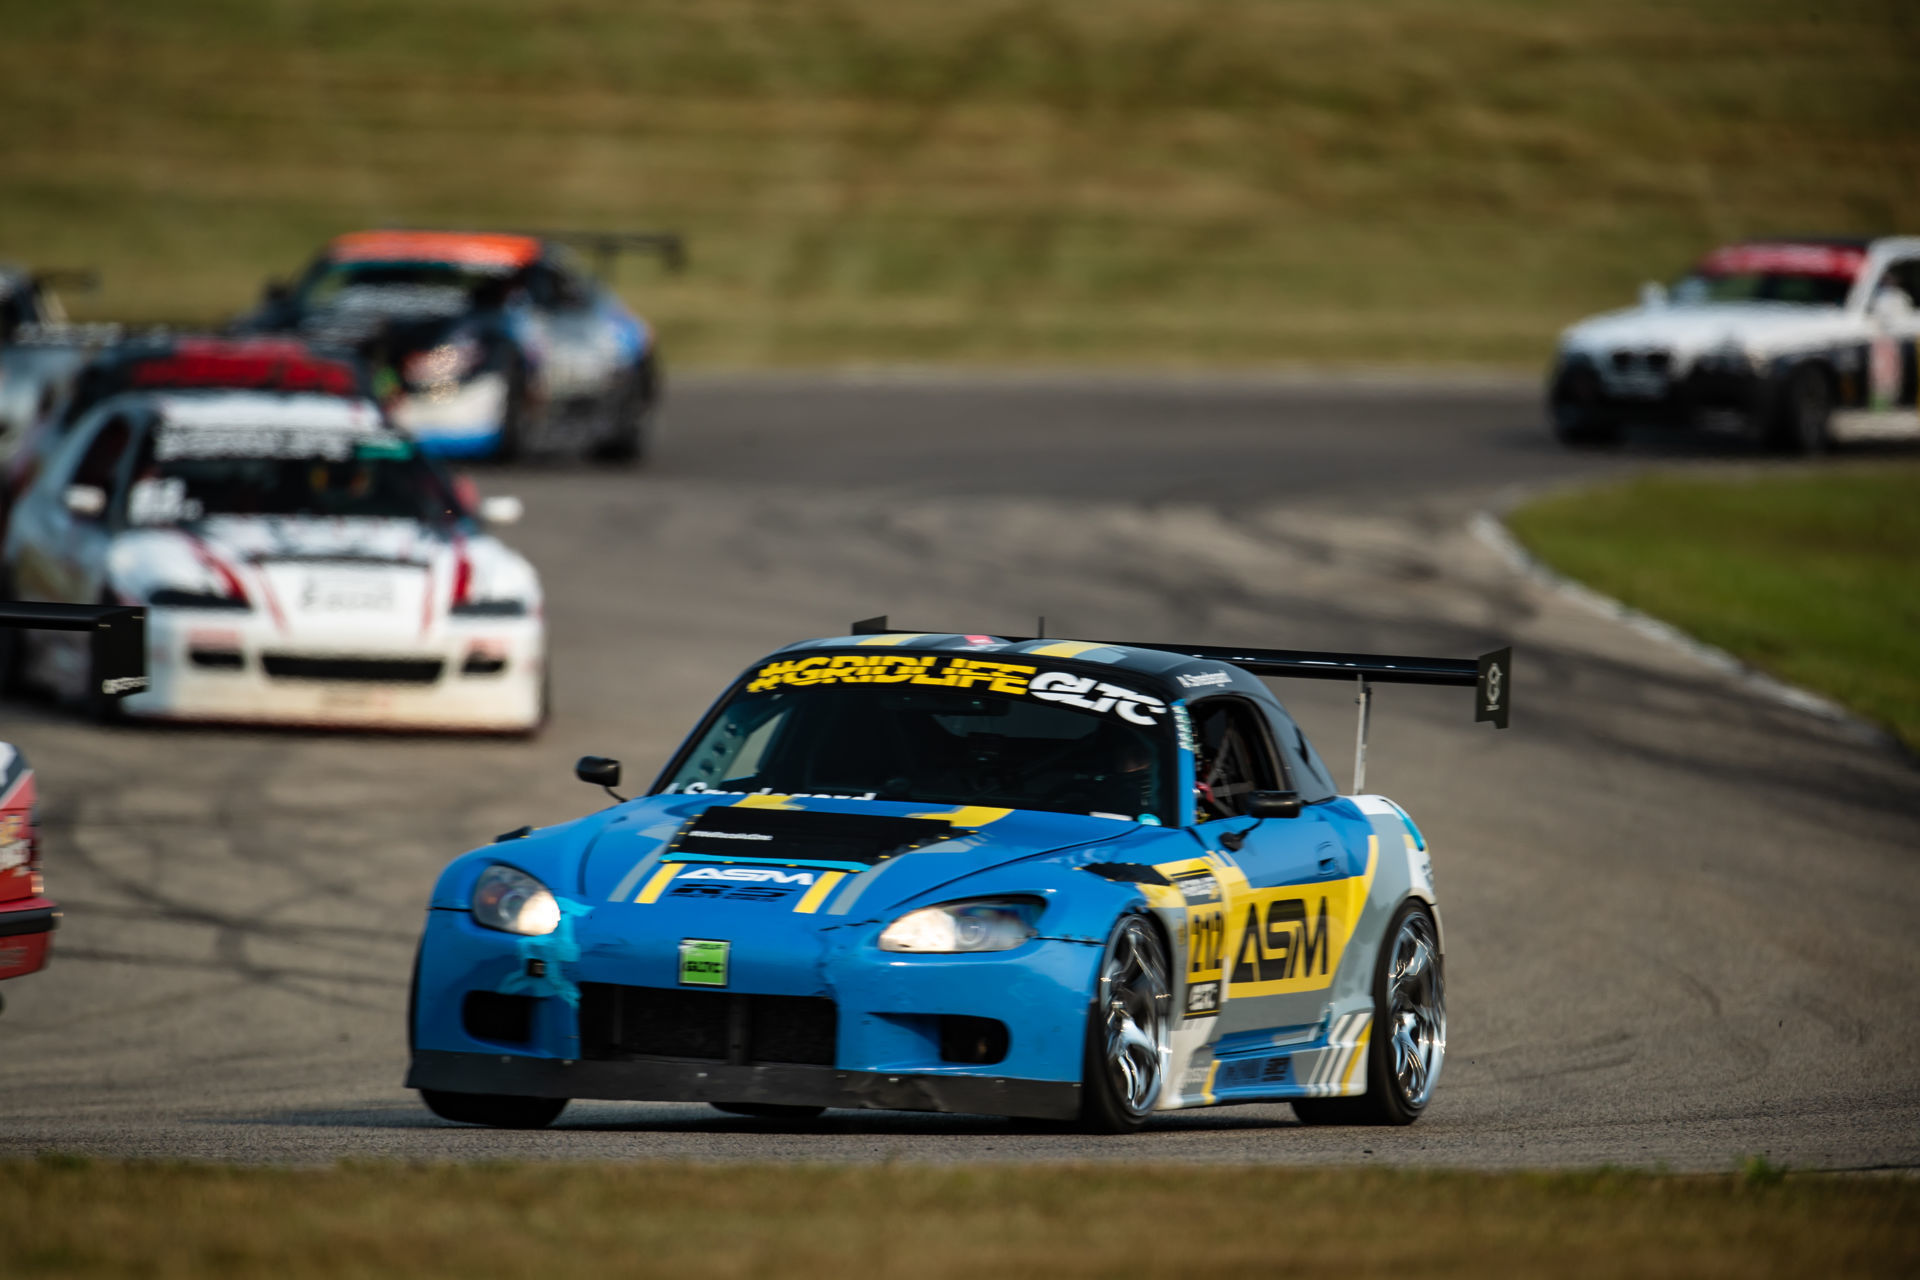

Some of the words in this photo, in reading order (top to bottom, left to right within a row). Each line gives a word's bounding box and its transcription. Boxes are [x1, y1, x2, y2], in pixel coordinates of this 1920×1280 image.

[746, 655, 1037, 695] #GRIDLIFE
[675, 867, 814, 886] ASM
[1231, 895, 1330, 983] ASM
